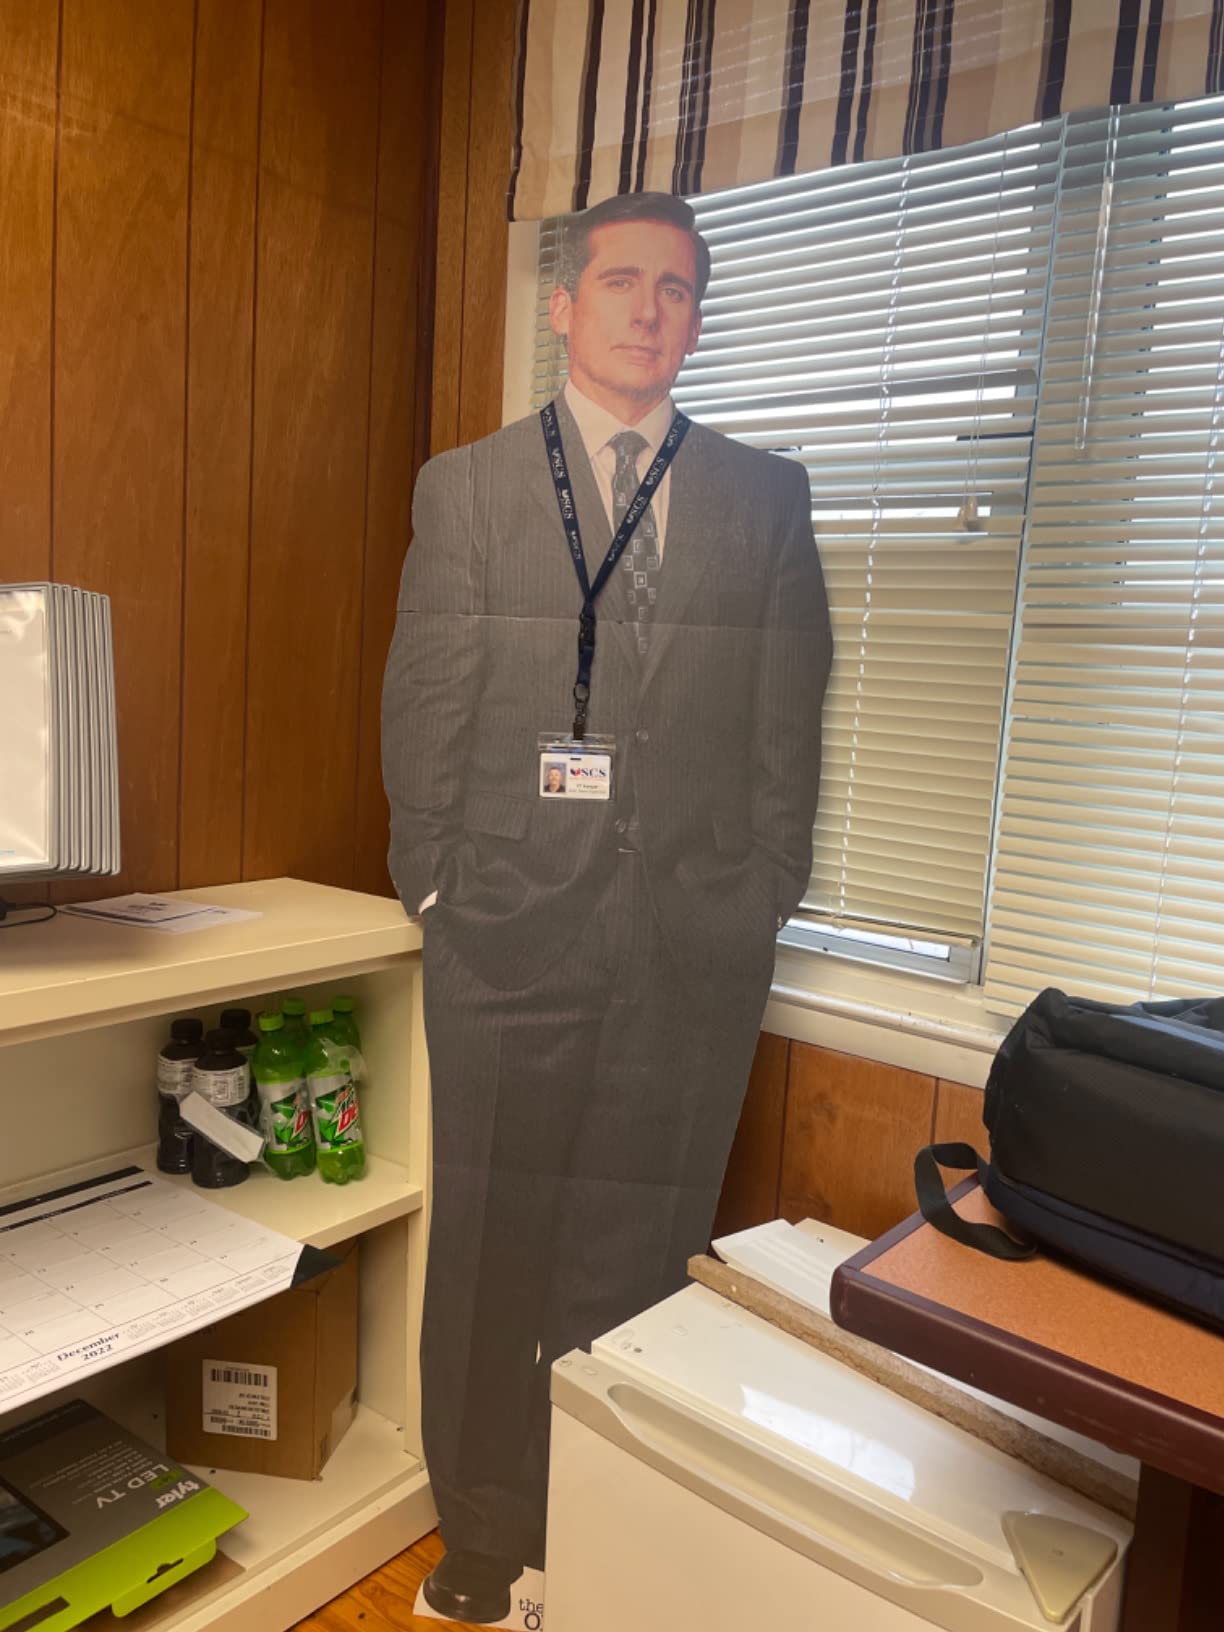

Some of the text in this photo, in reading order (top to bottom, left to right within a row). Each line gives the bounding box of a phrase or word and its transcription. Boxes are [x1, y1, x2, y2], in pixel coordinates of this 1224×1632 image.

[57, 1333, 119, 1361] December
[83, 1344, 112, 1361] 2022
[127, 1463, 169, 1489] LED
[96, 1489, 127, 1509] TV
[155, 1481, 200, 1509] tyler
